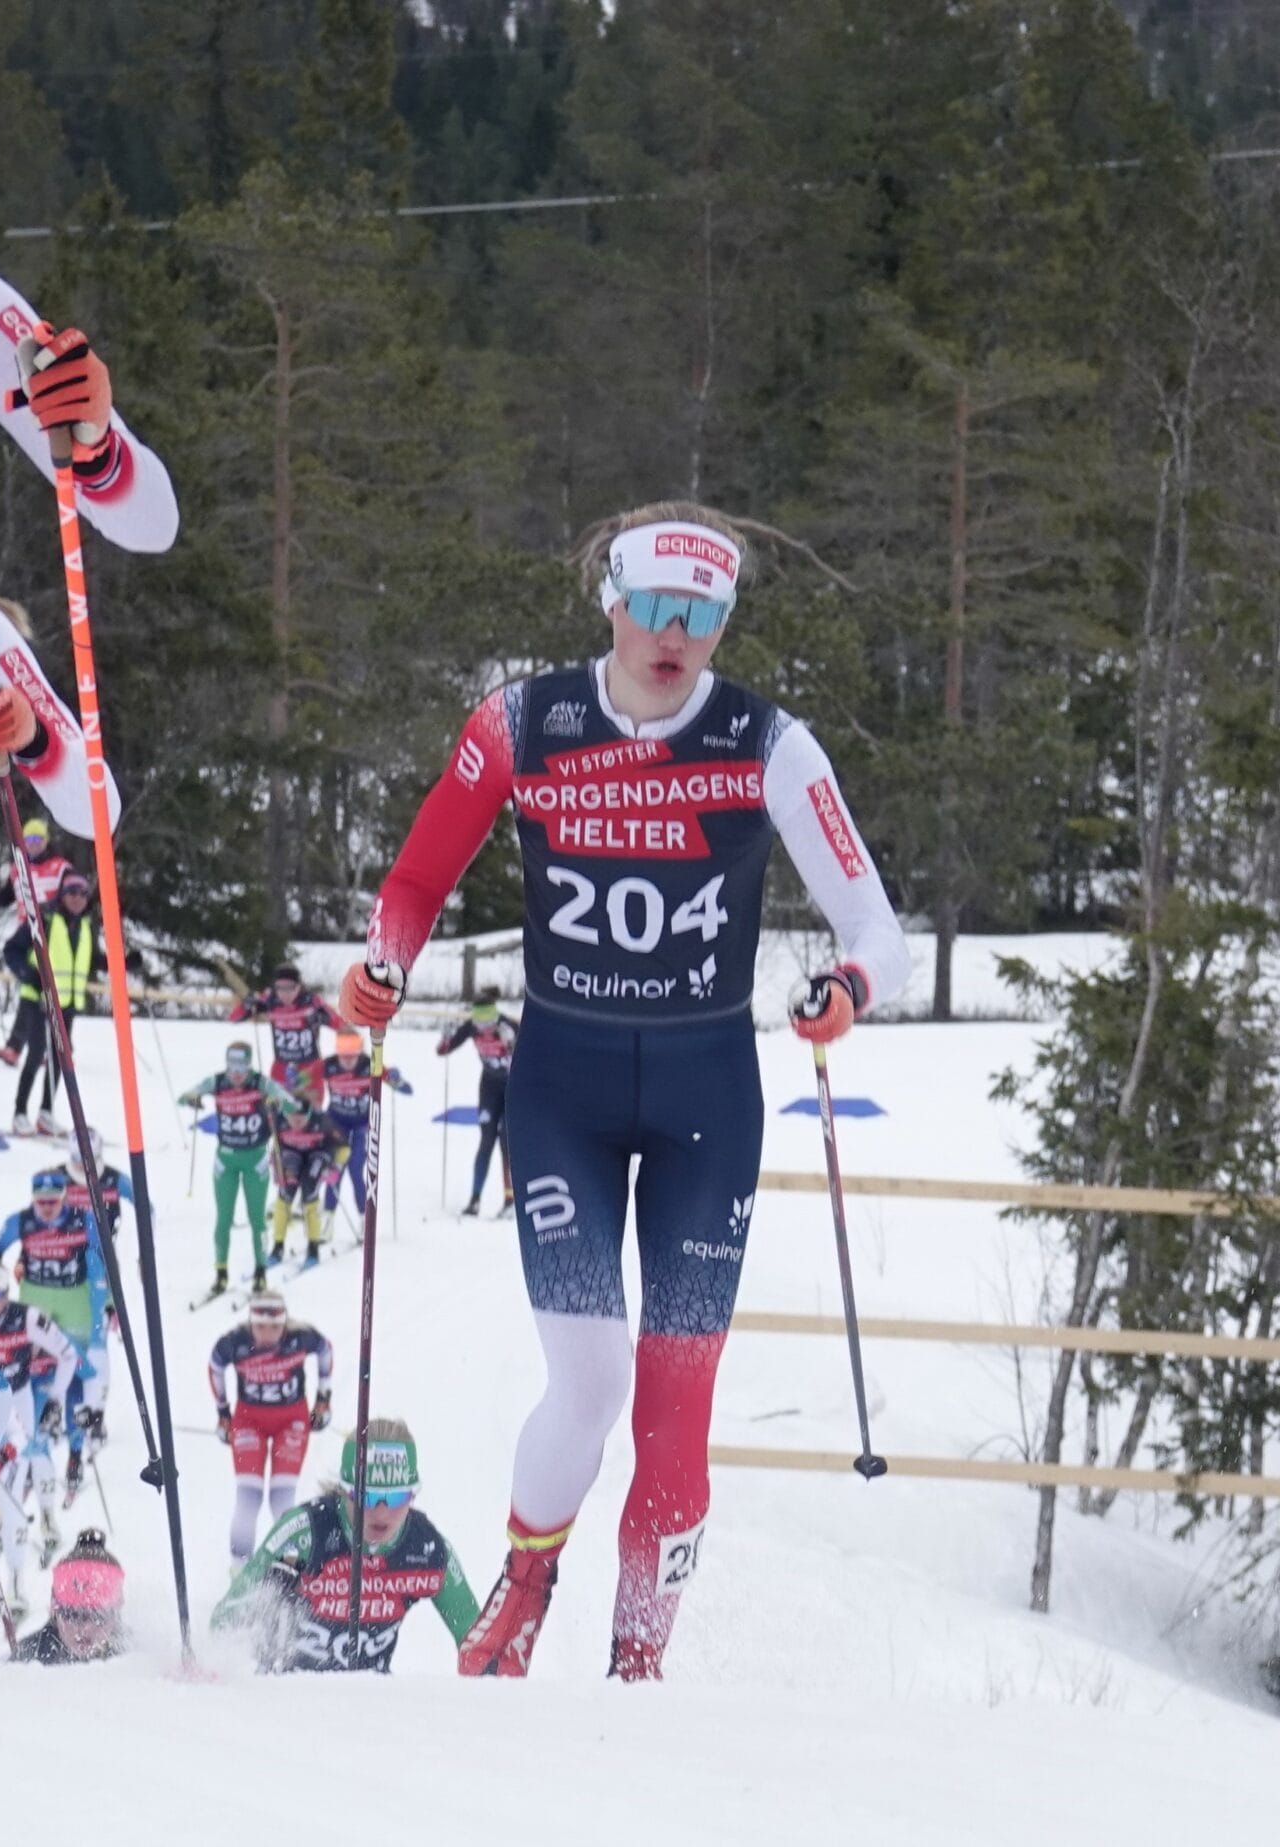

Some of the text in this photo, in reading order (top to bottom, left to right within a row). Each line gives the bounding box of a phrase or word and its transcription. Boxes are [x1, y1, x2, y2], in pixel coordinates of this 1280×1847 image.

[657, 535, 725, 565] equinor
[558, 742, 658, 778] VI STØTTER
[513, 773, 761, 811] MORGENDAGENS
[559, 816, 687, 850] HELTER
[814, 782, 854, 856] equinor
[545, 865, 730, 955] 204
[553, 963, 677, 1000] equinor
[221, 1113, 262, 1135] 240
